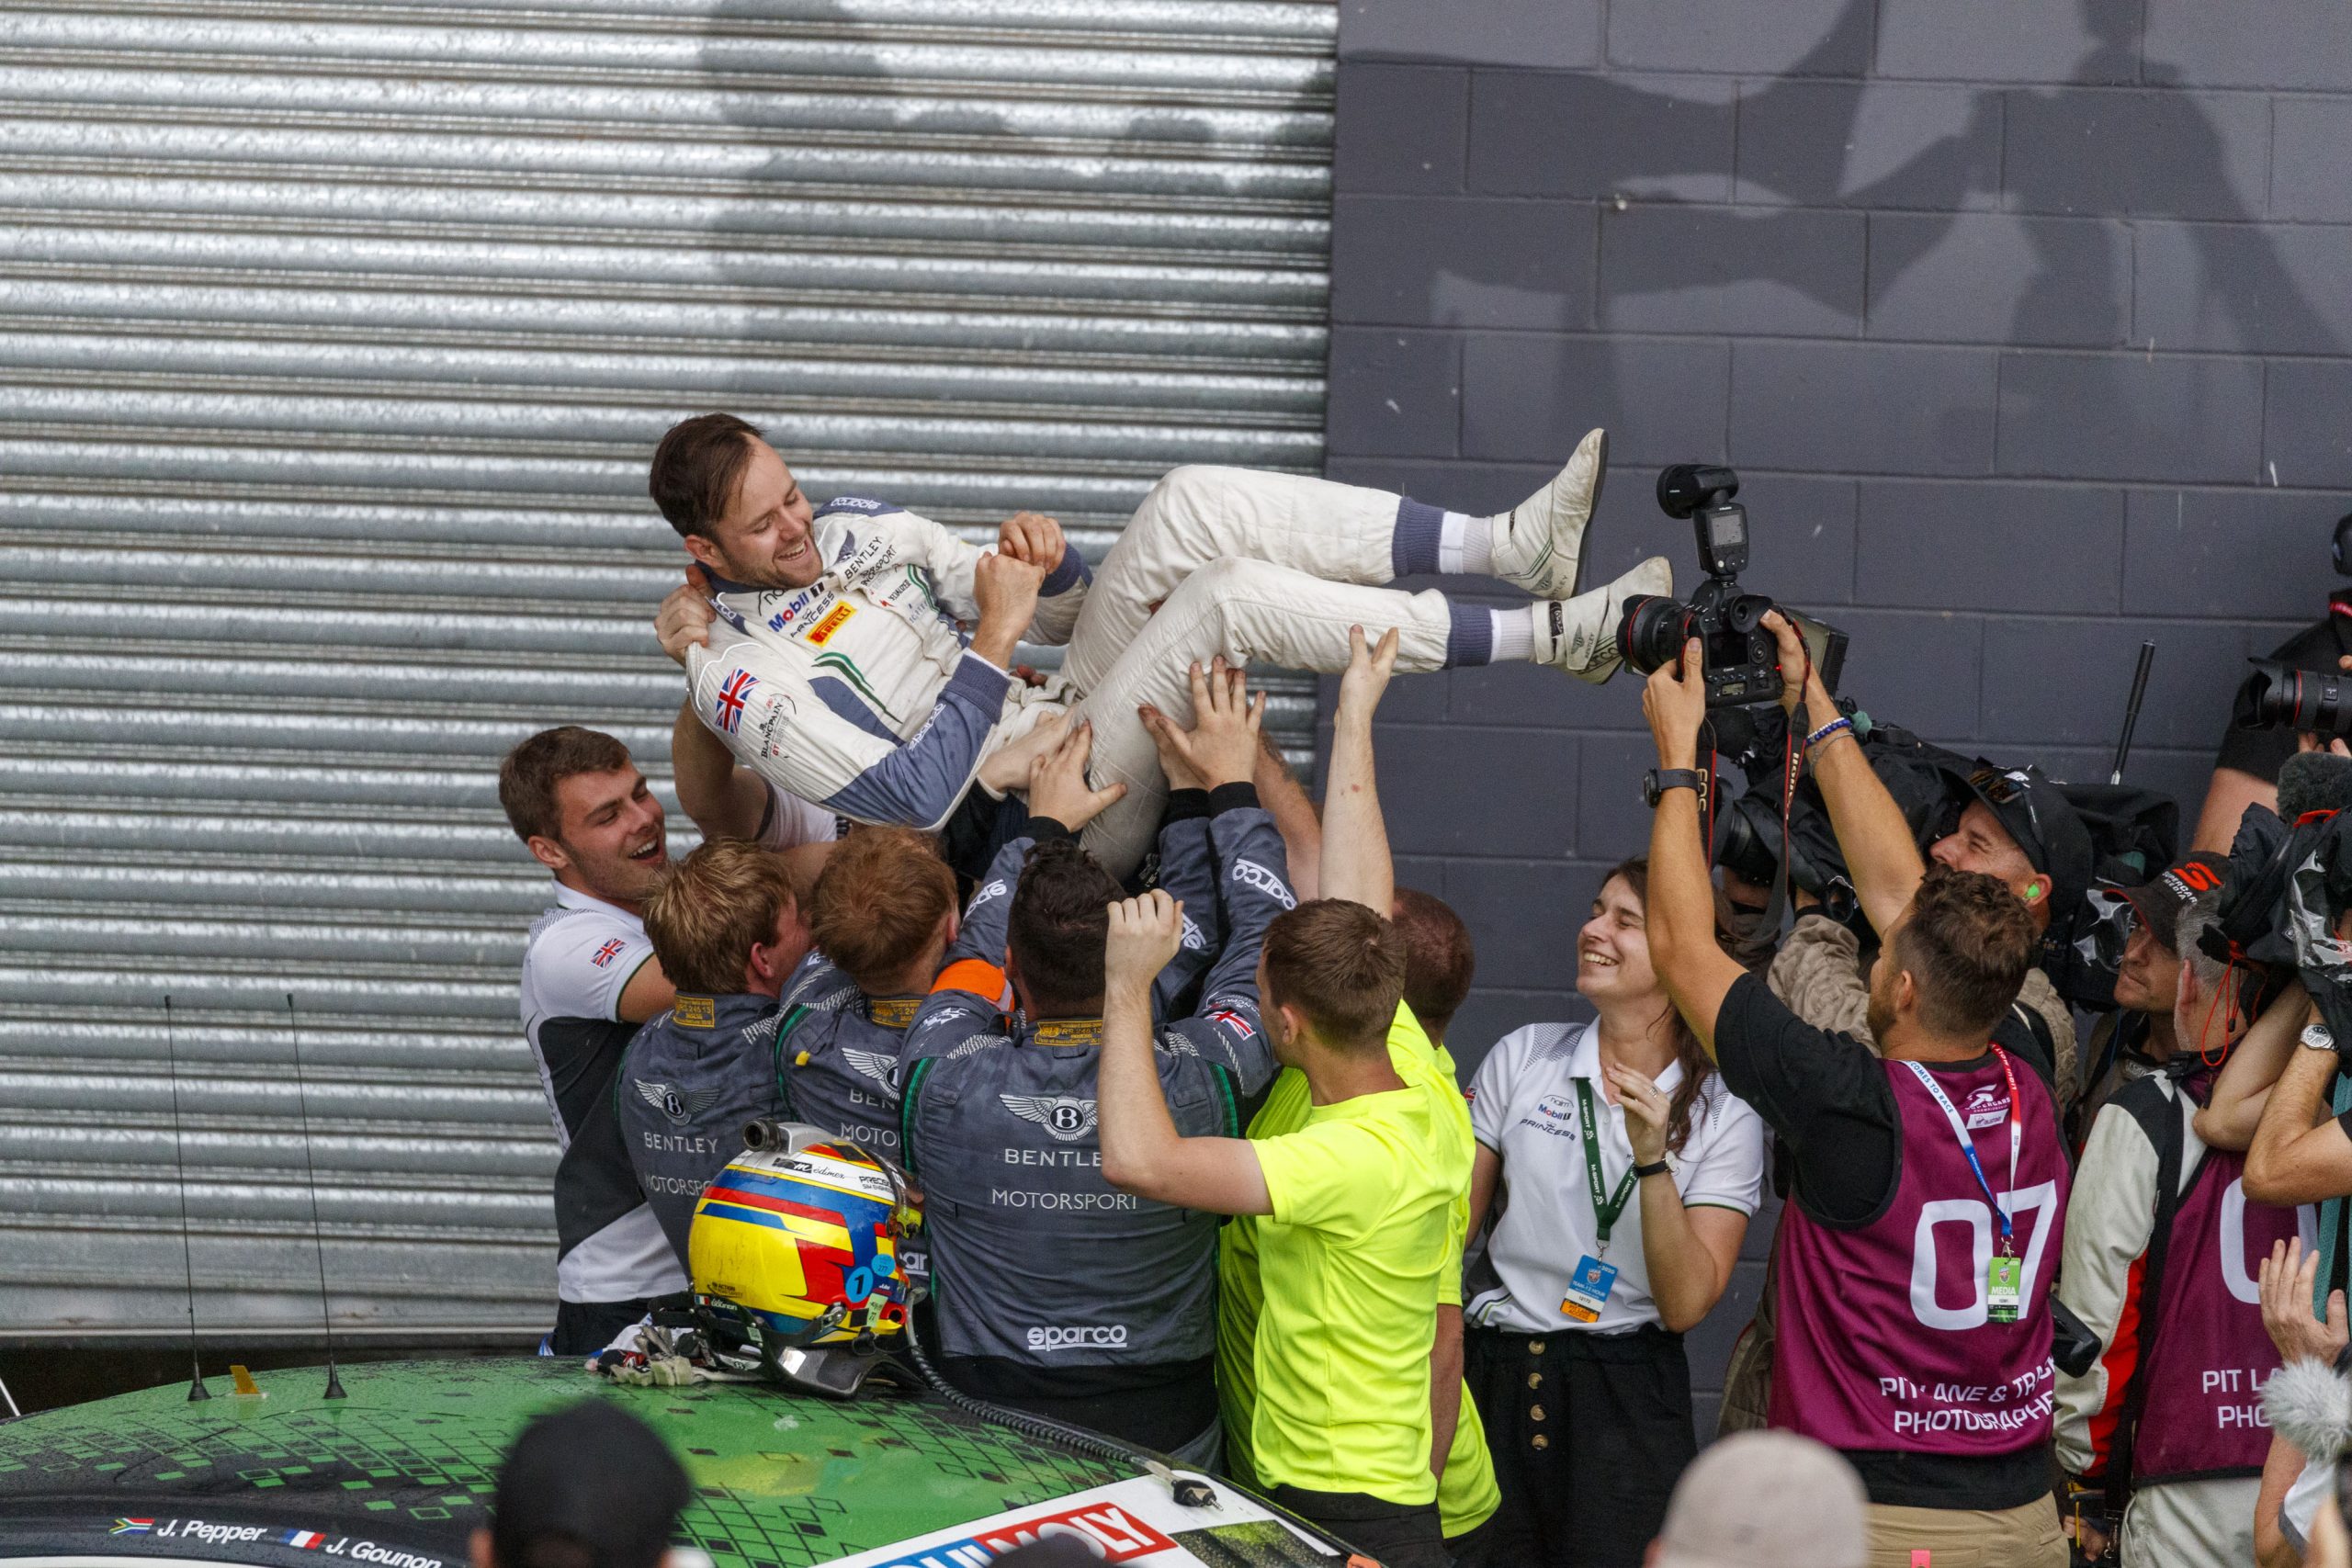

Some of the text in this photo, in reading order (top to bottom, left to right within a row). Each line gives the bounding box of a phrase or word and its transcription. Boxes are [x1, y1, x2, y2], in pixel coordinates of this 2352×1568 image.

[844, 536, 883, 581] BENTLEY
[763, 586, 787, 606] na
[768, 591, 810, 633] Mobil
[761, 702, 784, 759] BLANCPAIN
[908, 703, 946, 751] sparco
[772, 743, 781, 757] GT
[1231, 858, 1297, 911] parco
[2162, 871, 2199, 906] SUPERCAR
[2163, 878, 2187, 900] MEDIA
[1910, 1062, 1954, 1114] COMES TO RACE
[1537, 1103, 1563, 1120] Mobil
[1551, 1097, 1570, 1108] naim
[1581, 1099, 1591, 1129] M-SPORT
[1520, 1118, 1577, 1142] PRINCESS
[644, 1132, 718, 1155] BENTLEY
[1004, 1148, 1102, 1168] BENTLE
[645, 1173, 712, 1197] MOTORSPO
[1590, 1164, 1600, 1194] M-SPORT
[991, 1189, 1137, 1211] MOTORSPORT
[1615, 1179, 1633, 1209] M-SPORT
[2220, 1175, 2319, 1305] 0
[1910, 1179, 2058, 1331] 07
[854, 1273, 865, 1294] 1
[1991, 1286, 2017, 1295] MEDIA
[1026, 1324, 1127, 1352] sparco
[1918, 1382, 1987, 1404] ANE
[1988, 1385, 2007, 1403] &
[2202, 1369, 2242, 1394] PIT
[1894, 1389, 2054, 1434] PHOTOGRAPHE
[156, 1519, 267, 1544] J. Pepper
[325, 1537, 443, 1568] J. Gounon
